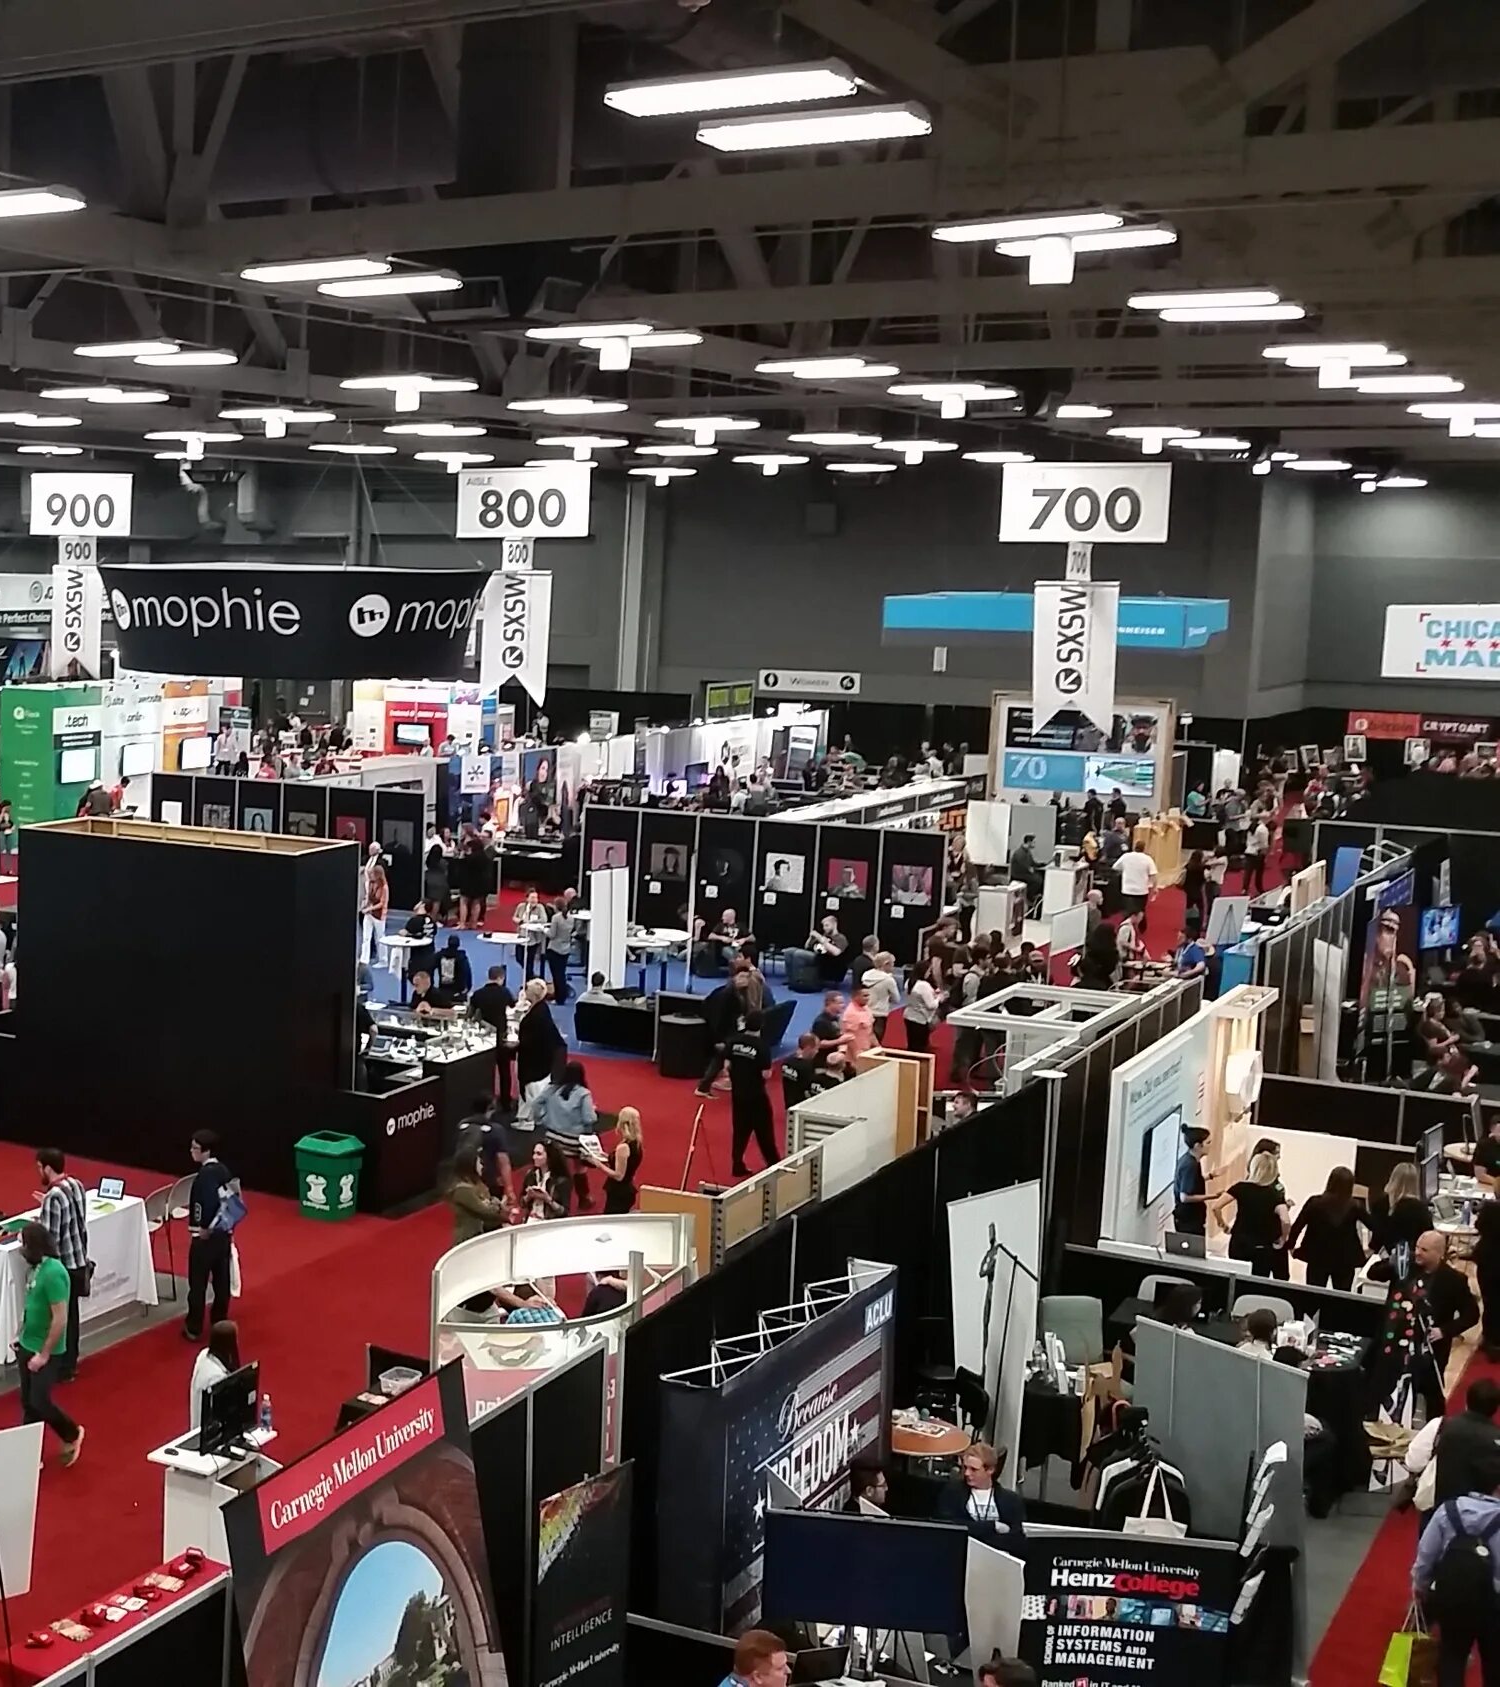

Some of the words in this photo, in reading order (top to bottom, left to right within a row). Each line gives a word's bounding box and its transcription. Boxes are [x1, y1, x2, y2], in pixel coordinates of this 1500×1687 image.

[46, 493, 116, 528] 900
[479, 488, 566, 529] 800
[1028, 486, 1141, 533] 700
[64, 541, 92, 561] 900
[507, 543, 530, 564] 800
[1070, 551, 1087, 574] 700
[65, 569, 85, 629] SXSW
[131, 586, 301, 638] mophie
[503, 573, 527, 642] SXSW
[1056, 586, 1088, 664] SXSW
[1426, 619, 1500, 639] CHICA
[1009, 755, 1048, 780] 70
[397, 1101, 436, 1129] mophie
[866, 1292, 893, 1332] ACLU
[776, 1382, 839, 1442] Because
[270, 1473, 334, 1530] Carnegie
[332, 1446, 379, 1490] Mellon
[375, 1408, 435, 1460] University
[772, 1410, 851, 1499] REEDOM
[1052, 1556, 1102, 1569] Carnegie
[1104, 1557, 1143, 1571] Mellon
[1144, 1562, 1202, 1578] University
[550, 1607, 613, 1652] INTELLIGENCE
[1056, 1638, 1123, 1653] SYSTEMS
[1125, 1645, 1148, 1656] AND
[1057, 1624, 1155, 1643] INFORMATION
[1054, 1652, 1155, 1670] MANAGEMENT
